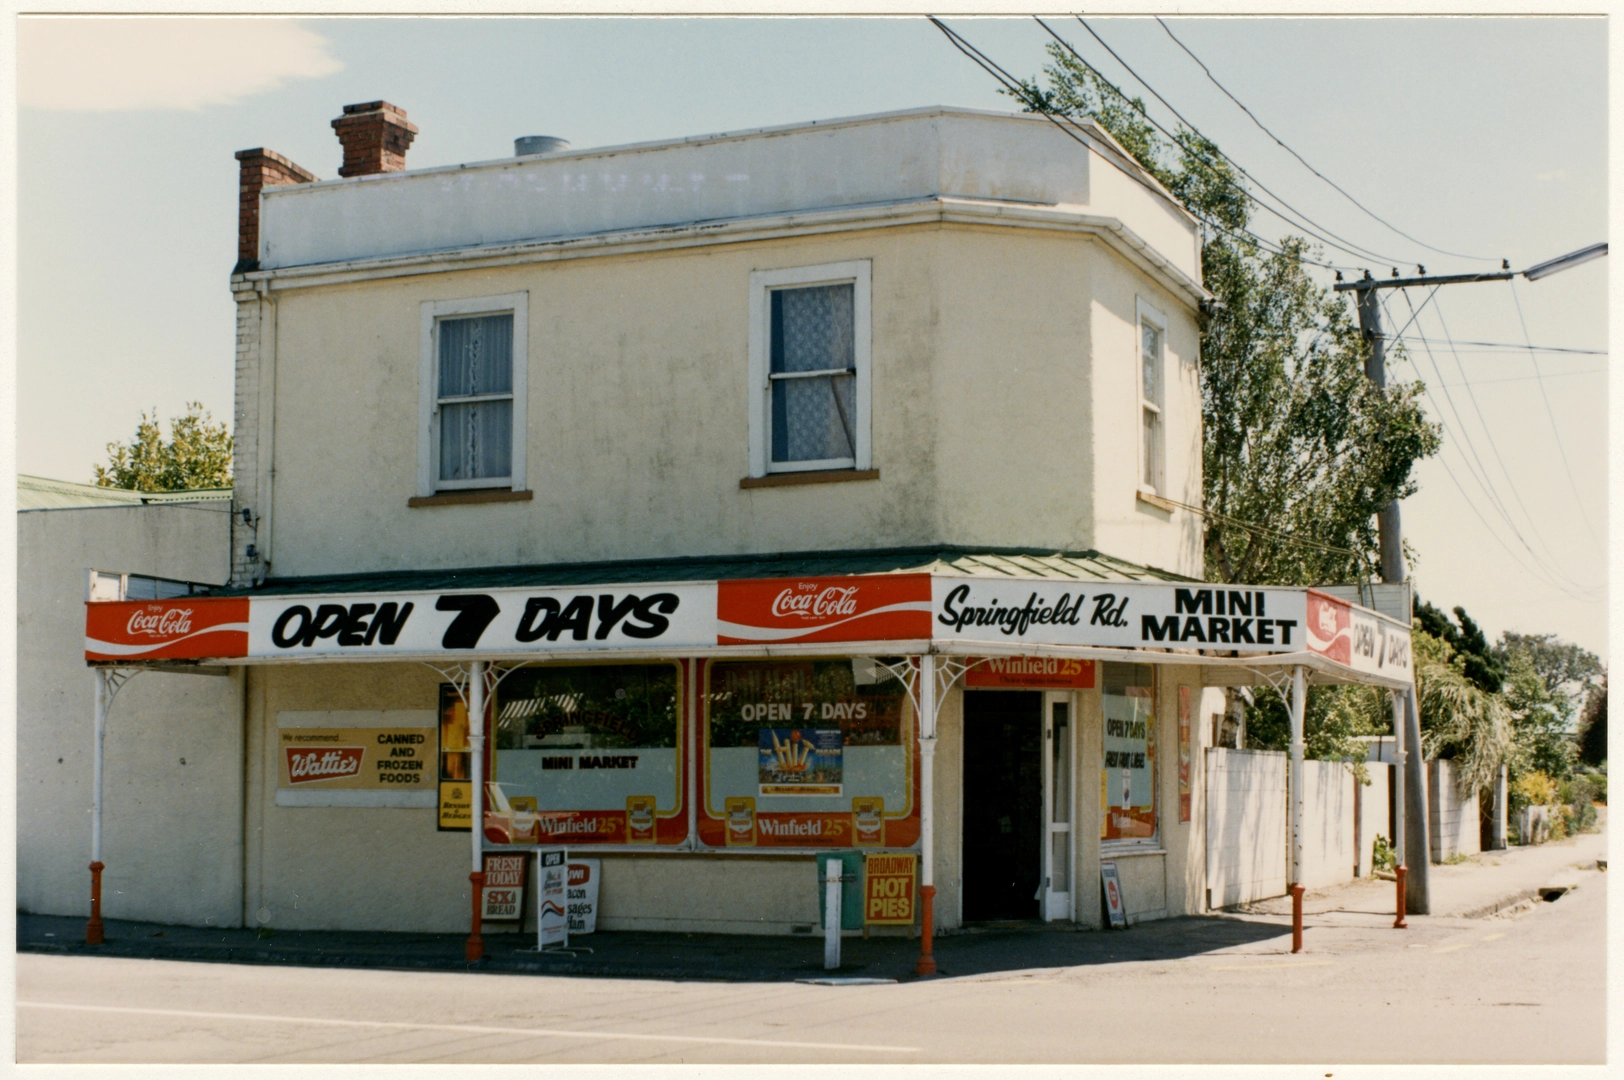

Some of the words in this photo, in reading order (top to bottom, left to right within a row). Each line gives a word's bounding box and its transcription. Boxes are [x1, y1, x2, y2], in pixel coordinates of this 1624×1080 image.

[799, 582, 818, 592] Enjoy
[147, 603, 163, 613] Enjoy
[771, 586, 860, 617] Coca-Cola
[937, 584, 1086, 636] Springfield
[1090, 593, 1129, 628] Rd.
[1174, 588, 1266, 617] MINI
[126, 607, 194, 636] Coca-Cola
[271, 601, 415, 648] OPEN
[435, 594, 501, 649] 7
[515, 592, 680, 642] DAYS
[1141, 614, 1298, 645] MARKET
[1353, 622, 1376, 659] OPEN
[1376, 620, 1387, 669] 7
[1388, 633, 1409, 669] DAYS
[988, 657, 1058, 675] Winfield
[740, 703, 792, 722] OPEN
[801, 703, 815, 720] 7
[821, 702, 868, 720] DAYS
[534, 709, 641, 742] SPRINGFIELD
[1107, 718, 1124, 738] OPEN
[1125, 720, 1130, 738] 7
[1130, 720, 1146, 740] DAYS
[282, 733, 293, 742] We
[377, 733, 425, 745] CANNED
[389, 747, 416, 758] AND
[290, 750, 359, 777] Wattie's
[376, 760, 424, 771] FROZEN
[541, 756, 574, 770] MINI
[579, 755, 639, 770] MARKET
[379, 773, 421, 784] FOODS
[539, 816, 597, 833] Winfield
[757, 818, 822, 836] Winfield
[486, 857, 523, 871] FRESH
[545, 852, 561, 866] OPEN
[868, 857, 914, 874] BROADWAY
[486, 871, 522, 885] TODAY
[567, 869, 584, 880] IWI
[567, 888, 586, 899] acon
[872, 877, 909, 898] HOT
[486, 905, 516, 916] BREAD
[567, 902, 592, 918] sages
[869, 897, 910, 918] PIES
